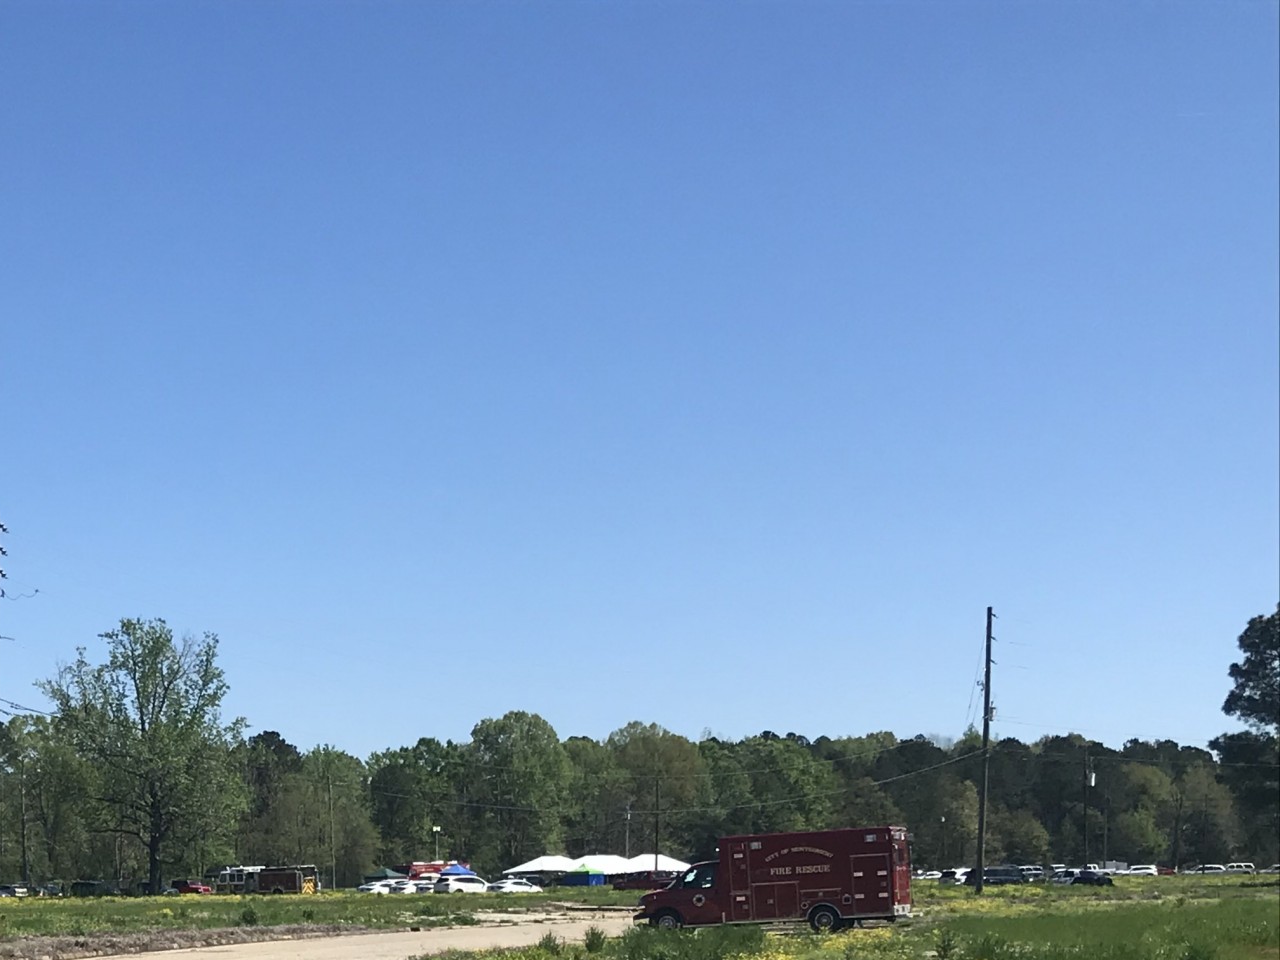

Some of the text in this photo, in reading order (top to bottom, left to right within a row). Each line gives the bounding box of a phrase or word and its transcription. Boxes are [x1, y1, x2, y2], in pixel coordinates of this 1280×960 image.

[765, 851, 779, 862] CITY
[770, 865, 830, 875] FIRE RESCUE
